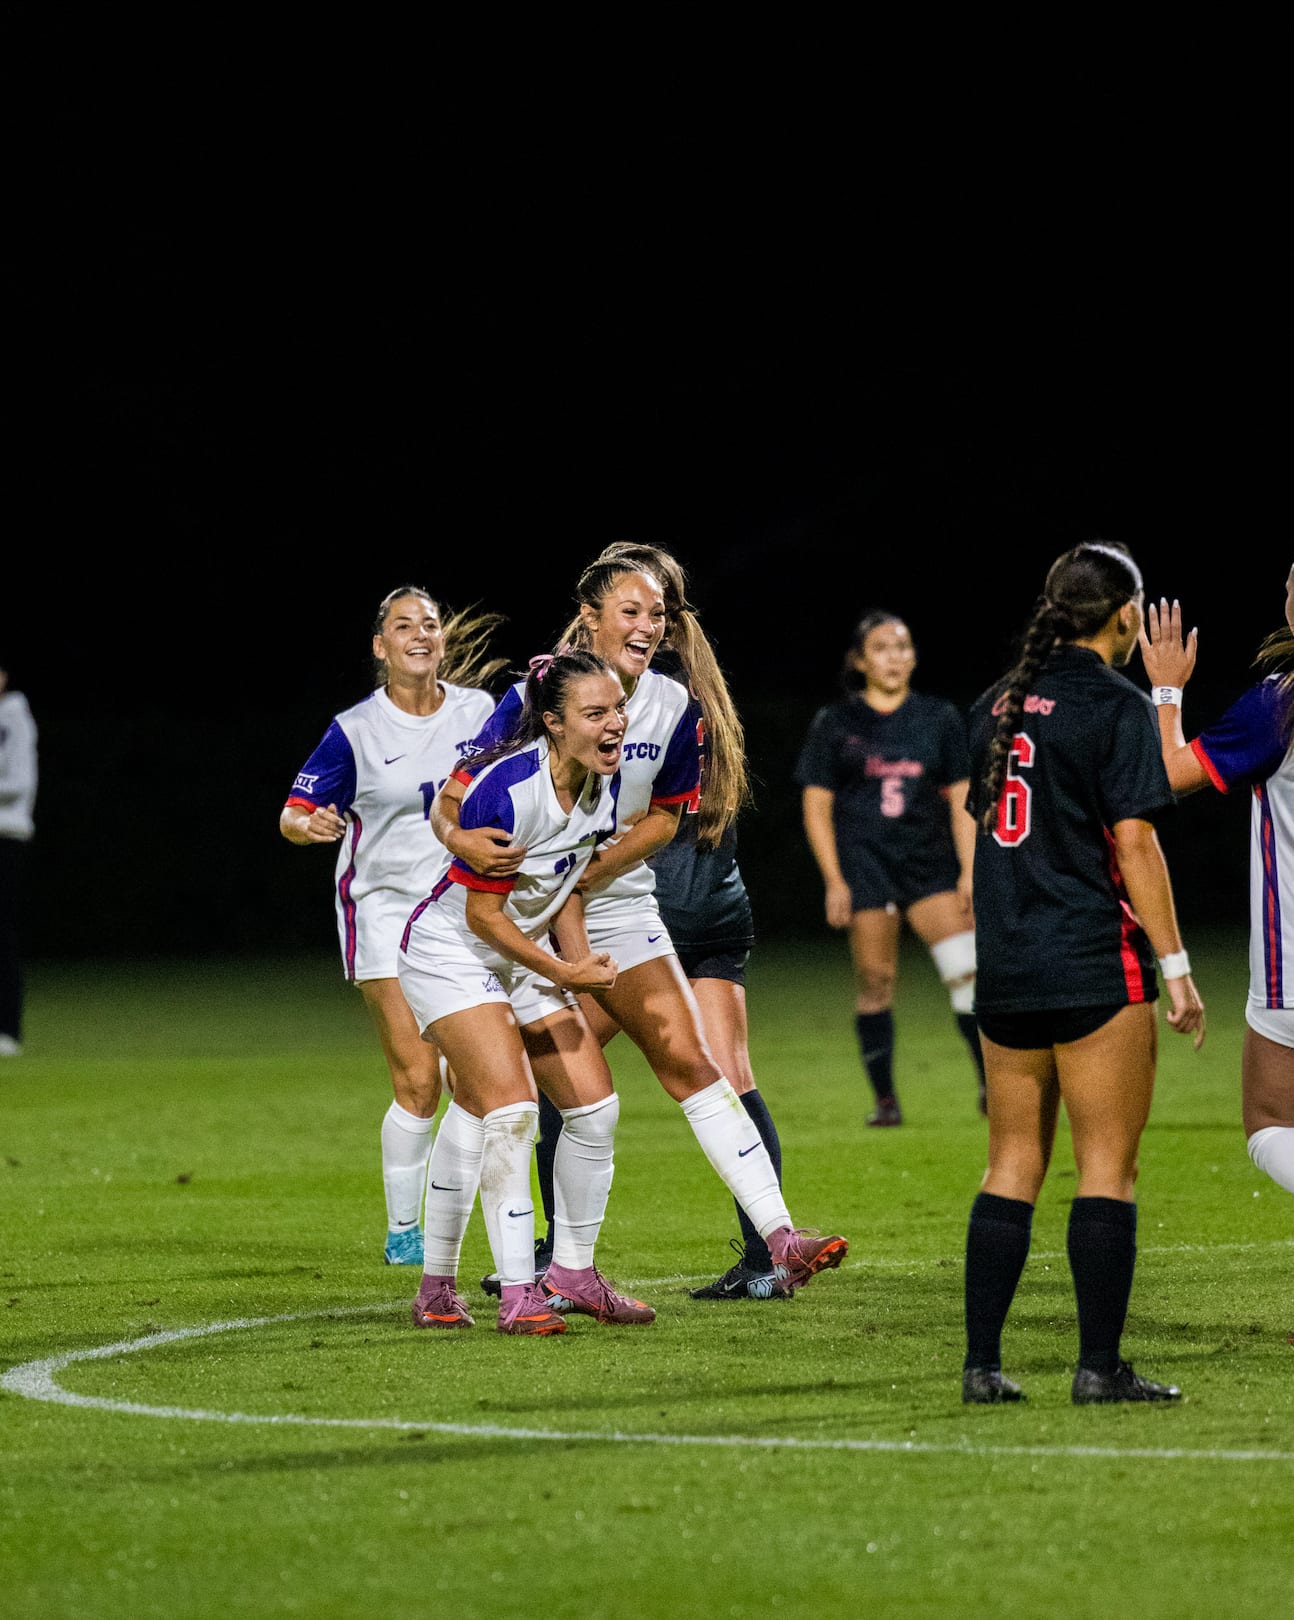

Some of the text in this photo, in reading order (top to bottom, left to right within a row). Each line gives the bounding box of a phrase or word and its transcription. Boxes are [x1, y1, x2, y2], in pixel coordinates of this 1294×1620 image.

[623, 742, 662, 762] TCU
[418, 778, 448, 821] 1
[881, 778, 905, 817] 5
[992, 732, 1036, 847] 6
